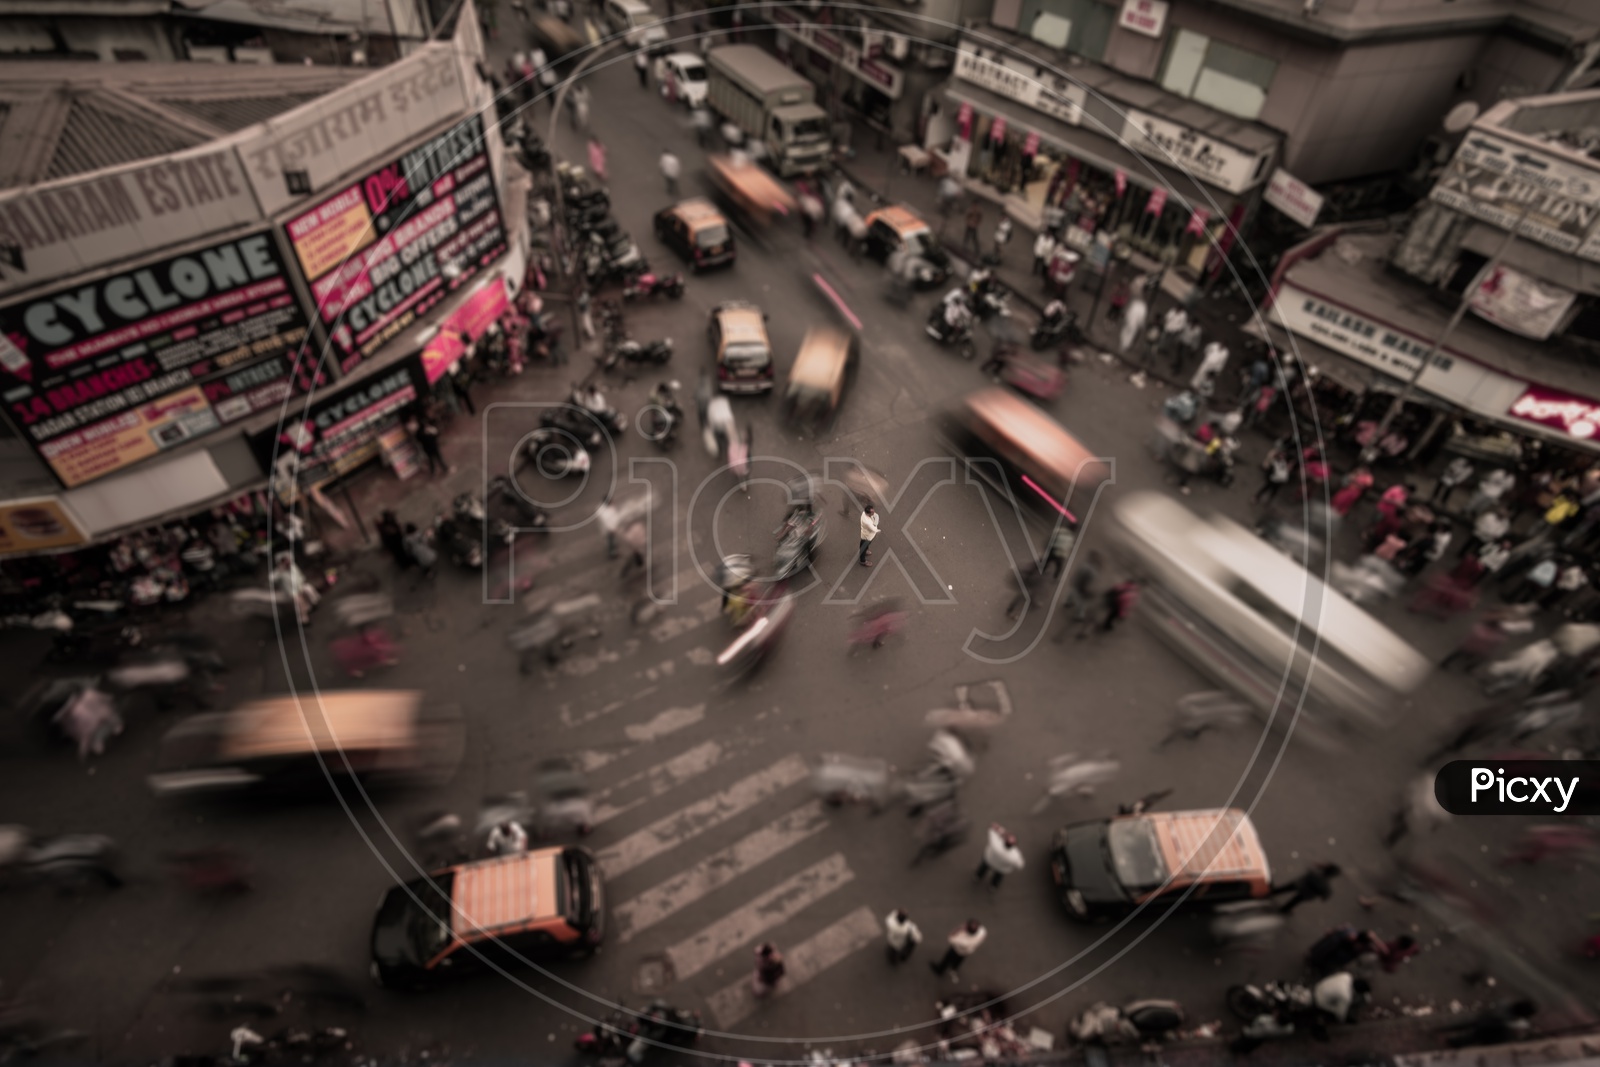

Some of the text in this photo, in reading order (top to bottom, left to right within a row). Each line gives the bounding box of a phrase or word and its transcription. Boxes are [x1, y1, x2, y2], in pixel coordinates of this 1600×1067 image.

[135, 150, 240, 217] ESTATE
[317, 188, 361, 221] MOBILE
[365, 162, 409, 216] 0%
[369, 255, 402, 286] BIG
[399, 217, 460, 263] OFFERS
[392, 198, 457, 247] BRANDS
[23, 234, 280, 346] CYCLONE
[349, 252, 438, 331] CYCLONE
[12, 393, 51, 425] 14
[29, 411, 78, 441] DADAR
[74, 394, 128, 425] STATION
[142, 368, 192, 397] BRANCH
[315, 367, 413, 428] CYCLONE
